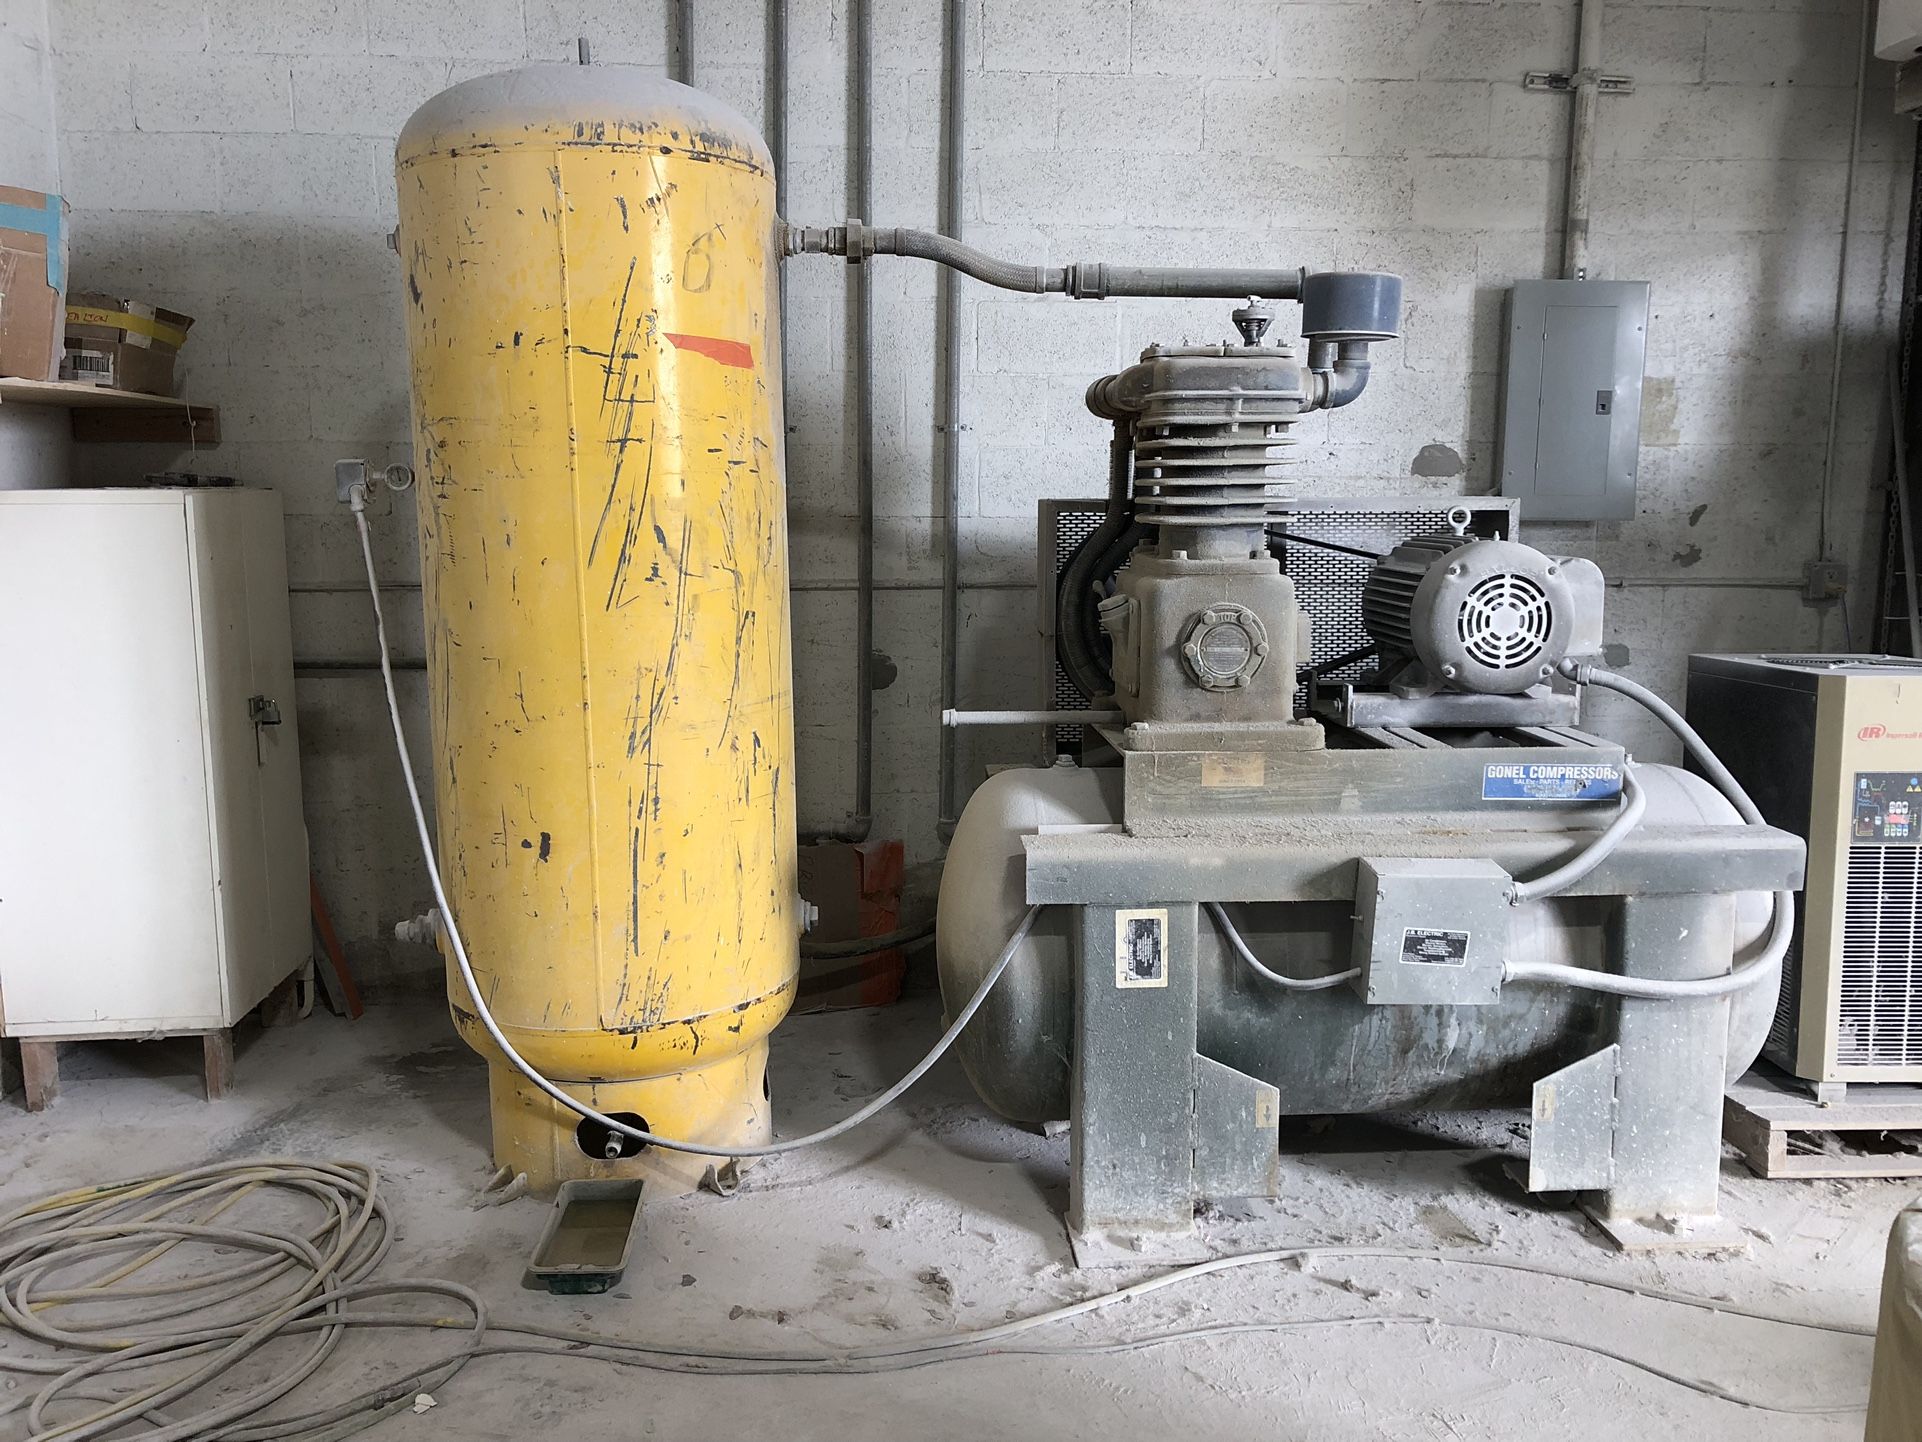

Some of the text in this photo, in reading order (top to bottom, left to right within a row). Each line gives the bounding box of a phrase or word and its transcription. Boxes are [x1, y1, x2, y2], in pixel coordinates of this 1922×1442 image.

[1861, 726, 1883, 739] IR
[1487, 765, 1618, 779] GONEL COMPRESSORS
